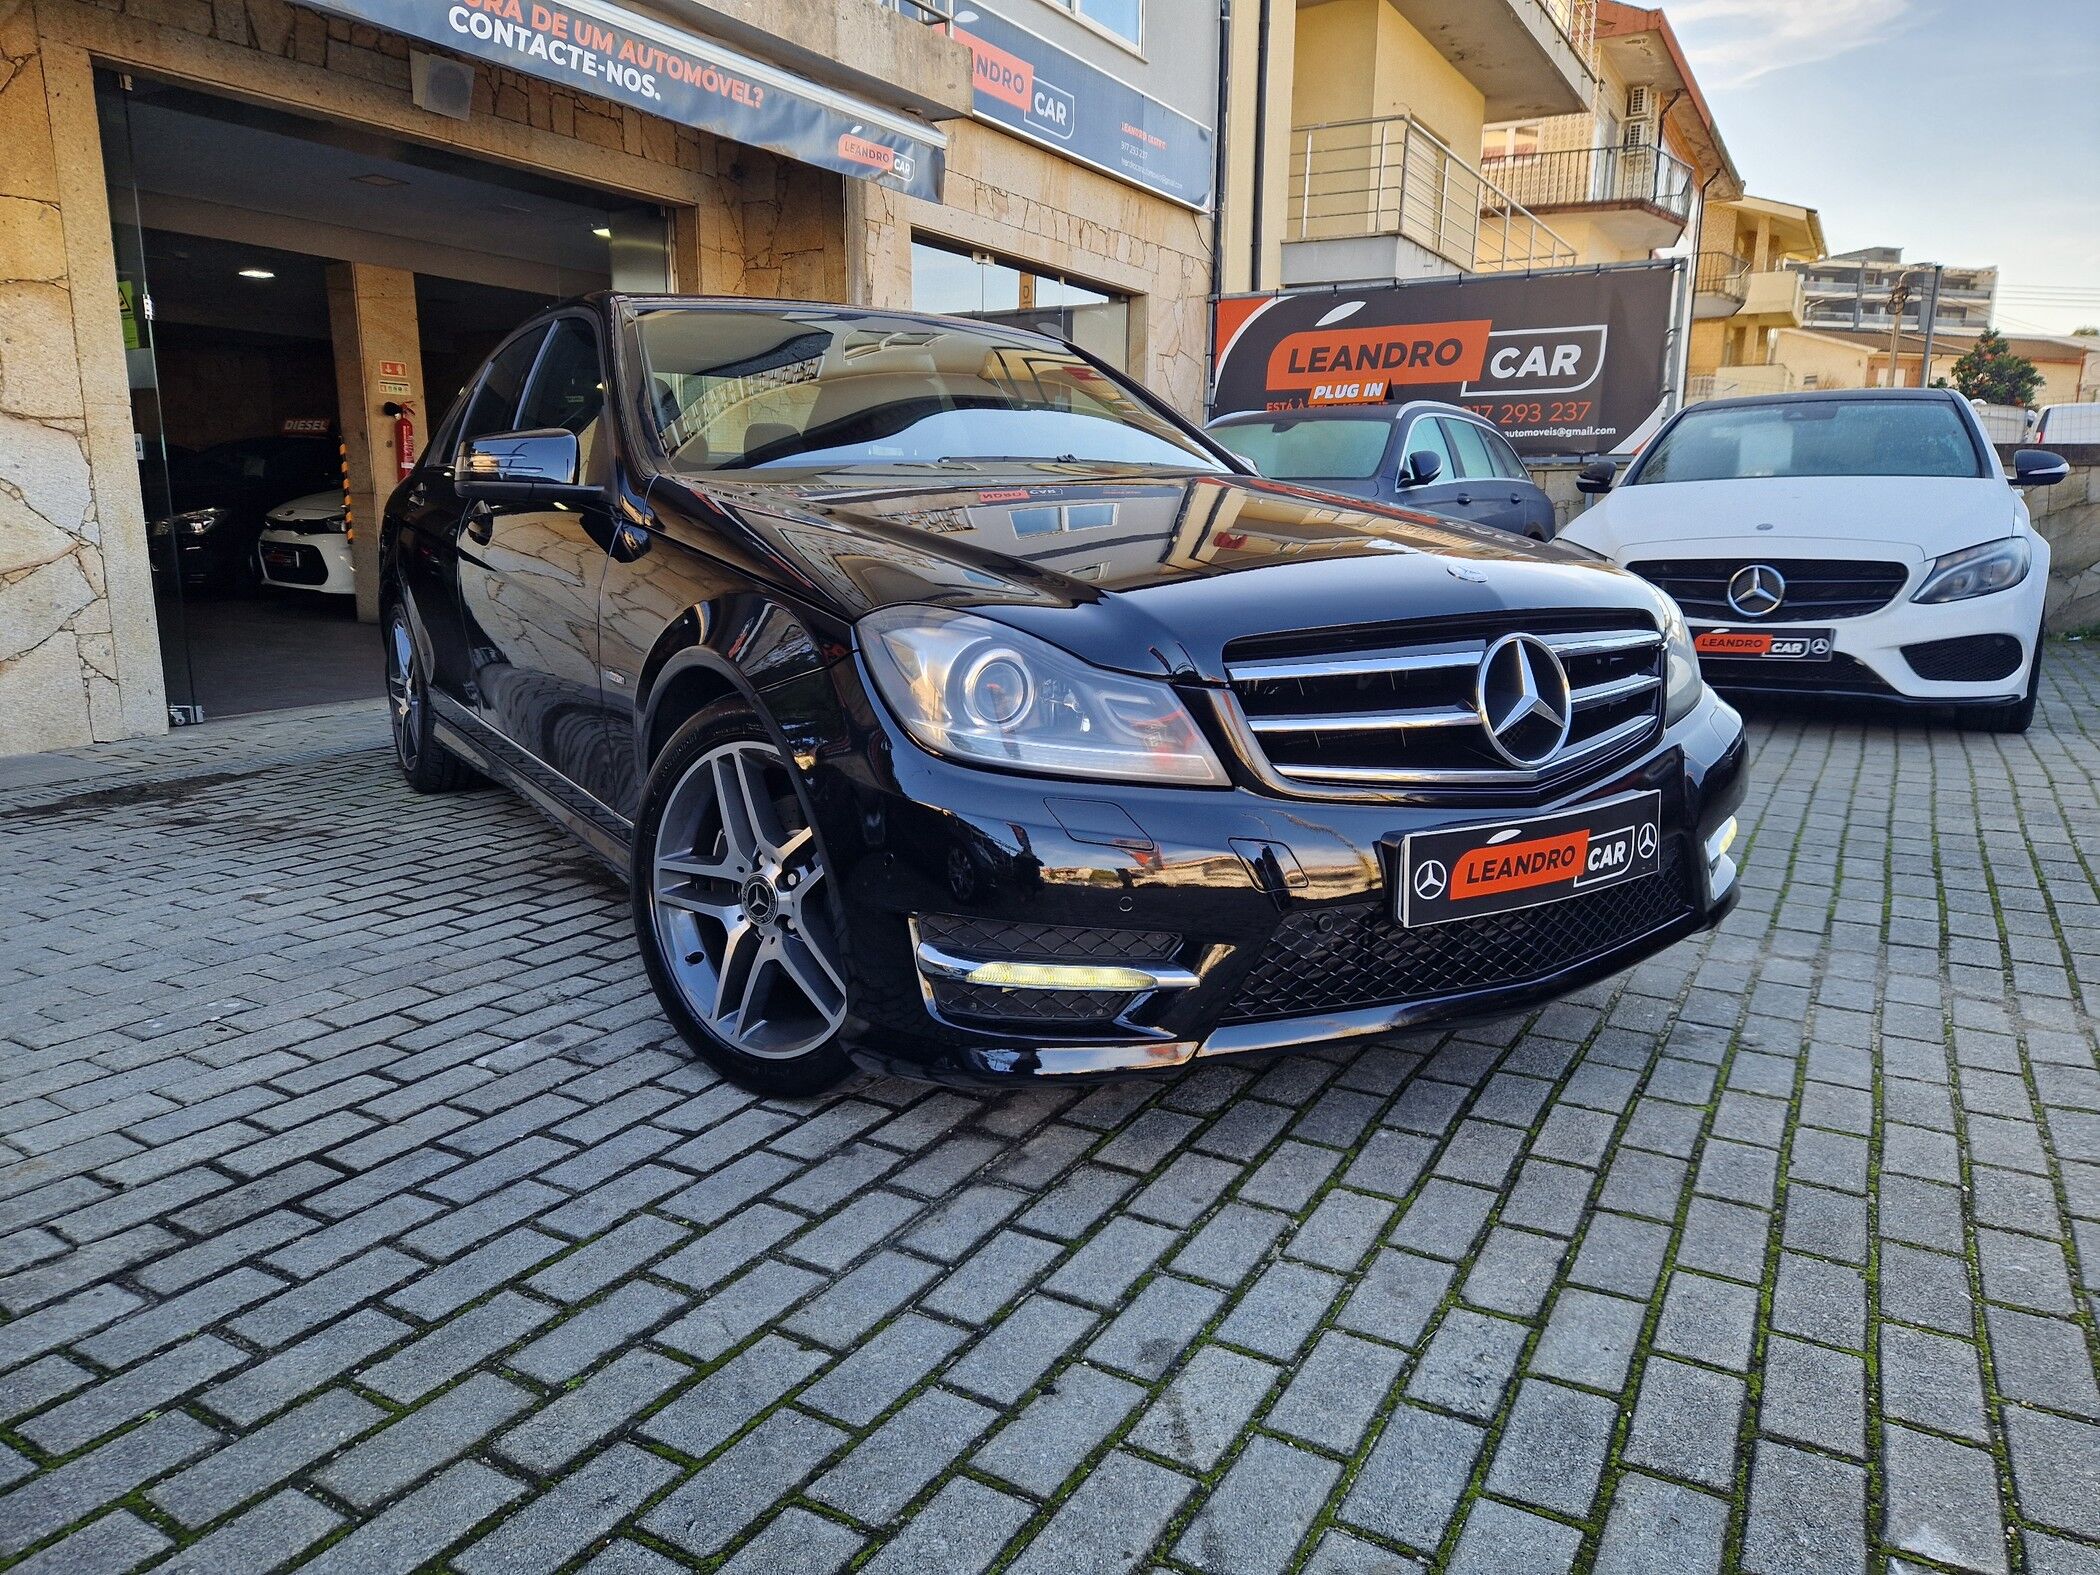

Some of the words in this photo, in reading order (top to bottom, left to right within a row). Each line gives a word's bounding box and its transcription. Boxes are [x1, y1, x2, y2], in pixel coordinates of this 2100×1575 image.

[448, 5, 662, 101] CONTACTE-NOS.
[531, 4, 568, 39] DE
[574, 21, 615, 56] UM
[618, 39, 765, 109] AUTOMÓVEL?
[1034, 91, 1067, 126] CAR
[844, 141, 890, 163] LEANDRO
[894, 158, 911, 175] CAR
[1287, 338, 1463, 374] LEANDRO
[1490, 344, 1582, 379] CAR
[1266, 398, 1294, 412] ESTÁ
[1313, 383, 1359, 400] PLUG
[1363, 382, 1384, 397] IN
[284, 419, 328, 431] DIESEL
[1461, 404, 1494, 419] 17
[1499, 403, 1542, 424] 293
[1548, 401, 1592, 422] 237
[1701, 638, 1763, 648] LEANDRO
[1771, 642, 1803, 653] CAR
[1466, 845, 1576, 885] LEANDRO
[1587, 840, 1626, 872] CAR
